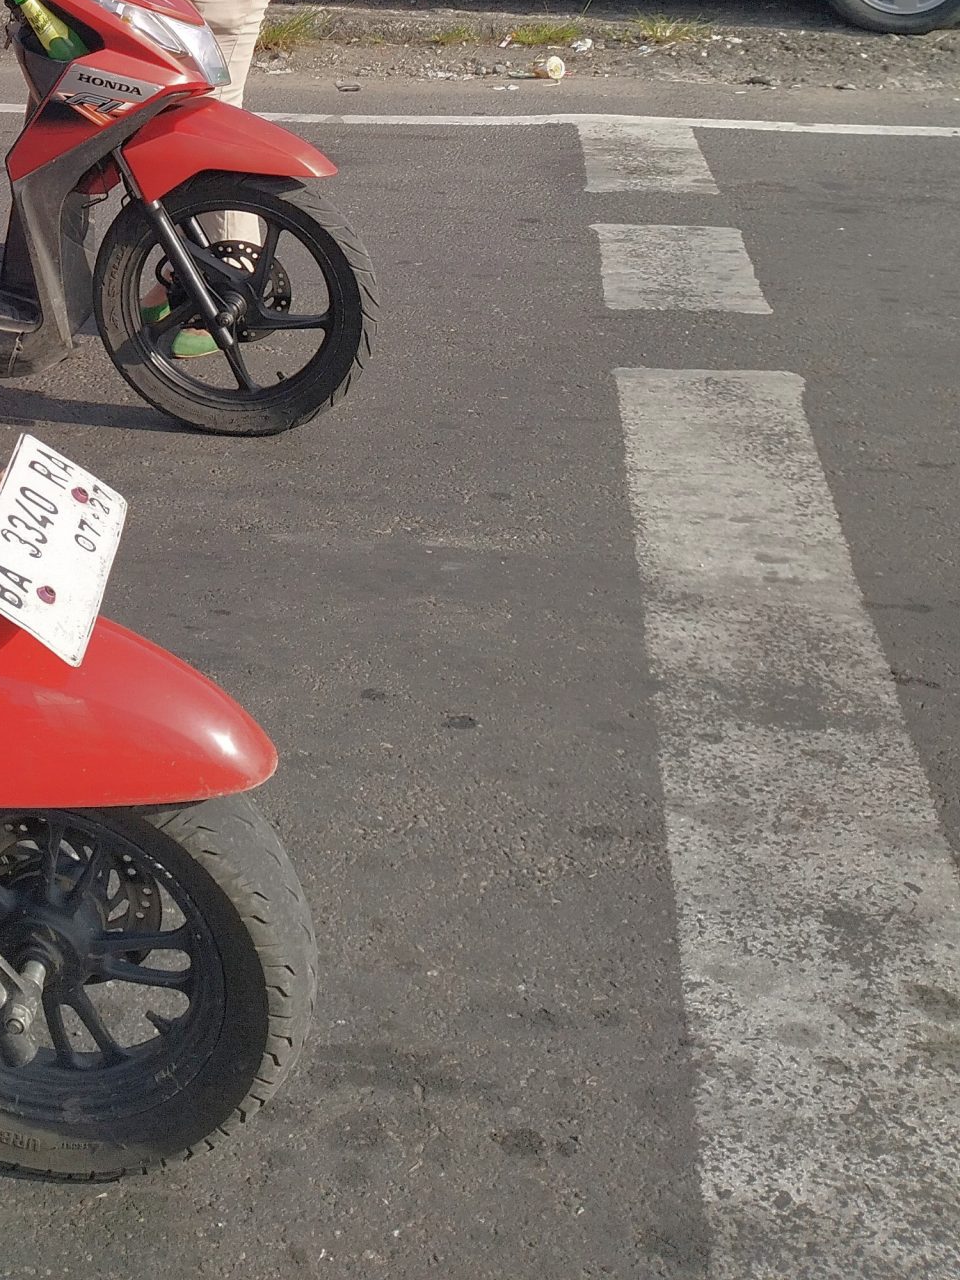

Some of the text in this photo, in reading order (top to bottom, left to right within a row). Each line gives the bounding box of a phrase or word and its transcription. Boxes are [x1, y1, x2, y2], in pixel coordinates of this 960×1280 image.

[77, 73, 143, 96] HONDA
[28, 448, 75, 490] RA
[1, 486, 59, 559] 3340
